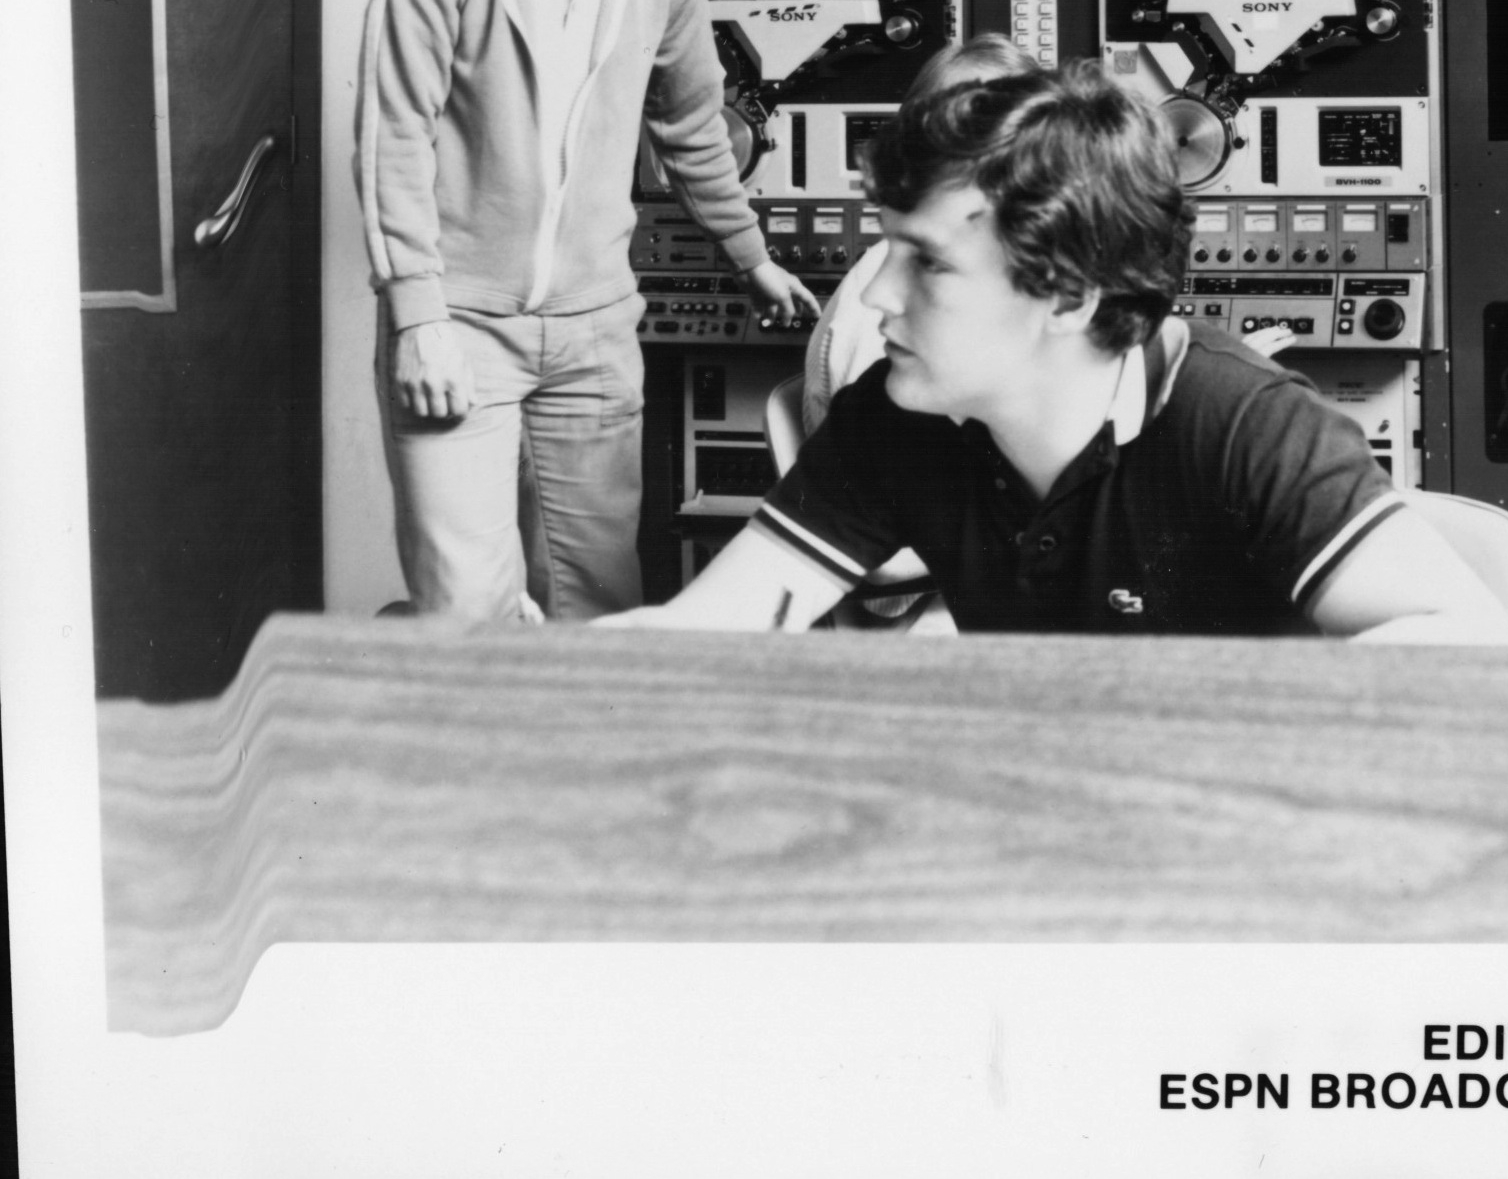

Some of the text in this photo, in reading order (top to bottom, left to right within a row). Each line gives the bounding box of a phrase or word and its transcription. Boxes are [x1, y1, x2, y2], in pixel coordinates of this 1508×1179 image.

[1242, 2, 1293, 13] SONY
[769, 12, 816, 22] SONY
[1335, 178, 1382, 186] BVH-1100
